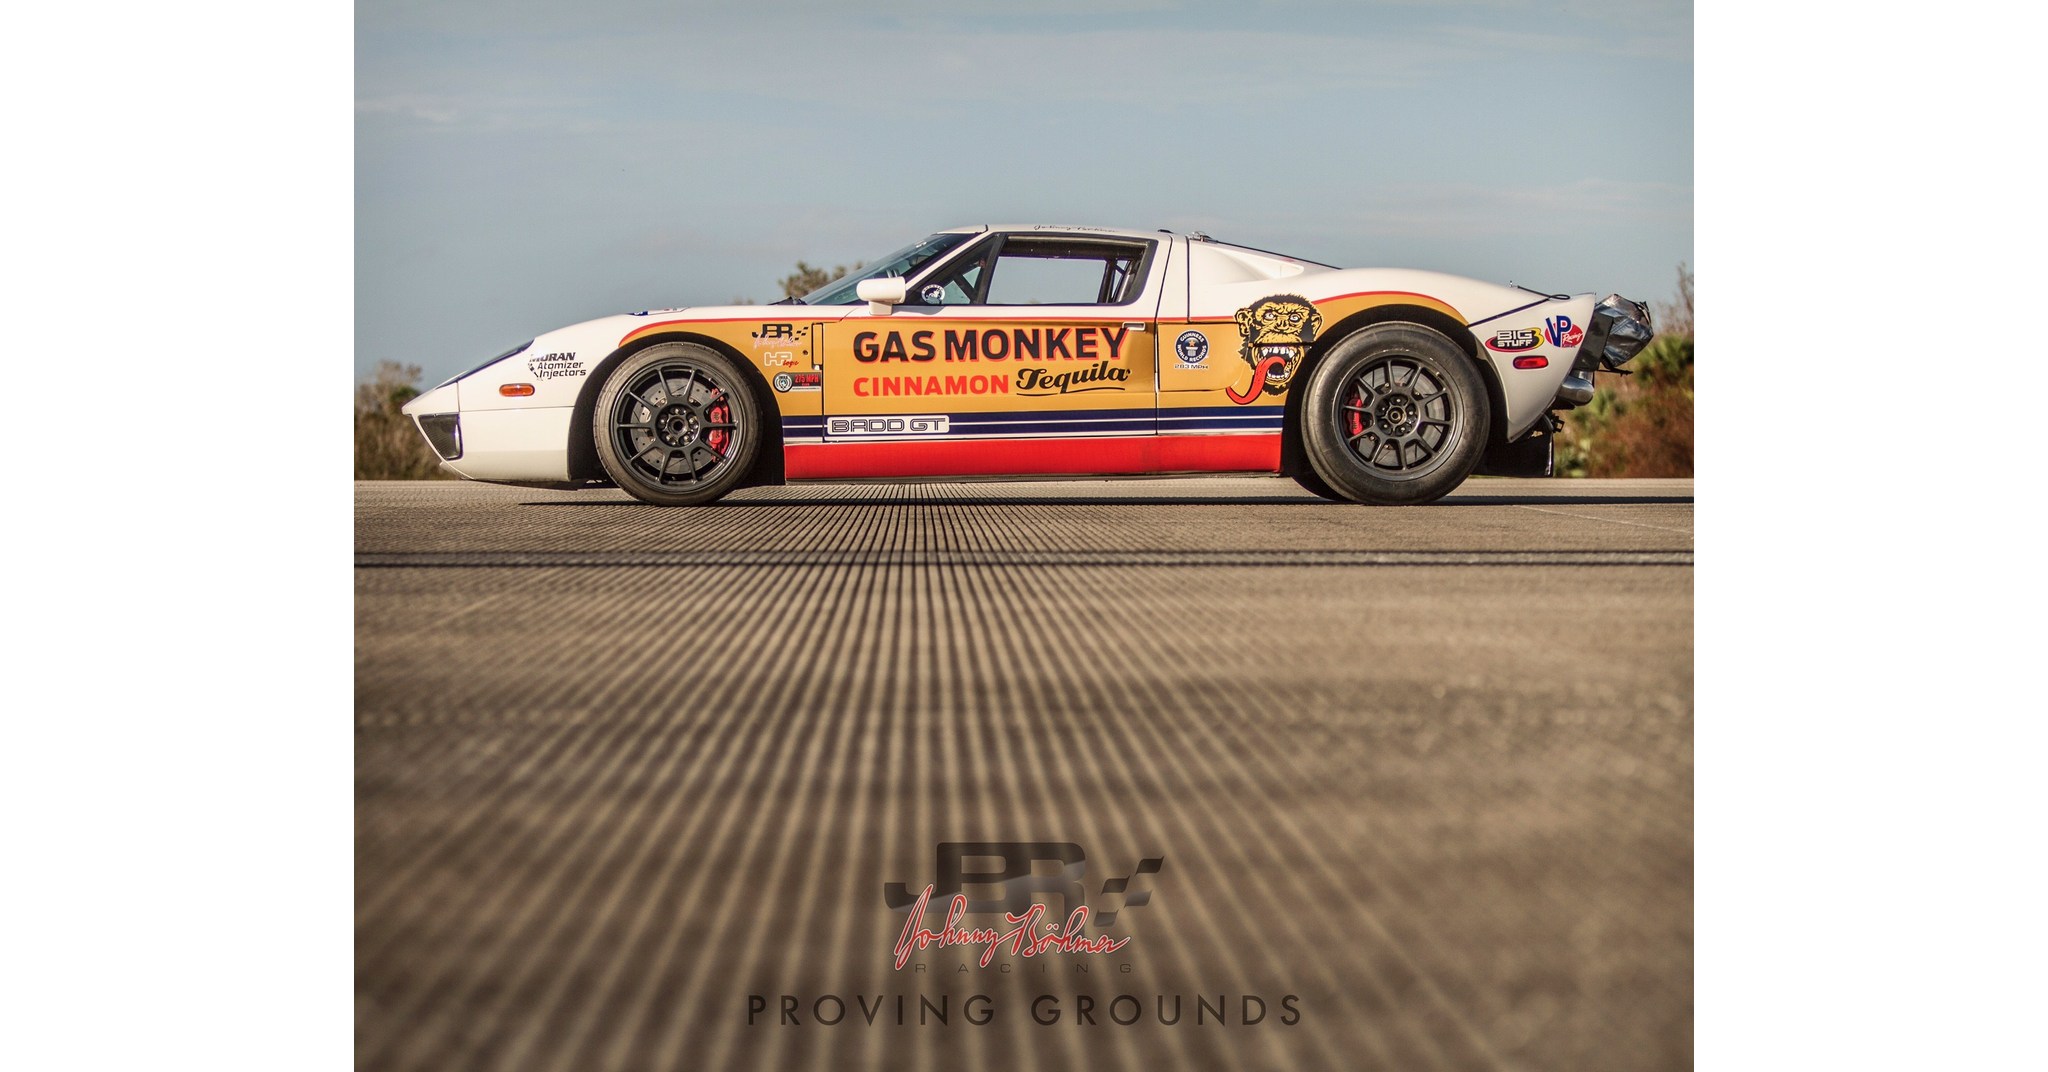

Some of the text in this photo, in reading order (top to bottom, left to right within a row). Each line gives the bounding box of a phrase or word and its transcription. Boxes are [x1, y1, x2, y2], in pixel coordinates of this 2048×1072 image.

[752, 324, 793, 340] JBR
[1497, 330, 1533, 340] BIG
[1545, 315, 1572, 348] VP
[853, 327, 1130, 363] GAS MONKEY
[1497, 340, 1533, 348] STUFF
[537, 361, 584, 370] Atomizer
[764, 352, 792, 367] HP
[540, 369, 587, 380] Injectors
[806, 373, 819, 383] MPH
[853, 360, 1131, 397] CINNAMON Tequila
[832, 418, 946, 432] BADD GT
